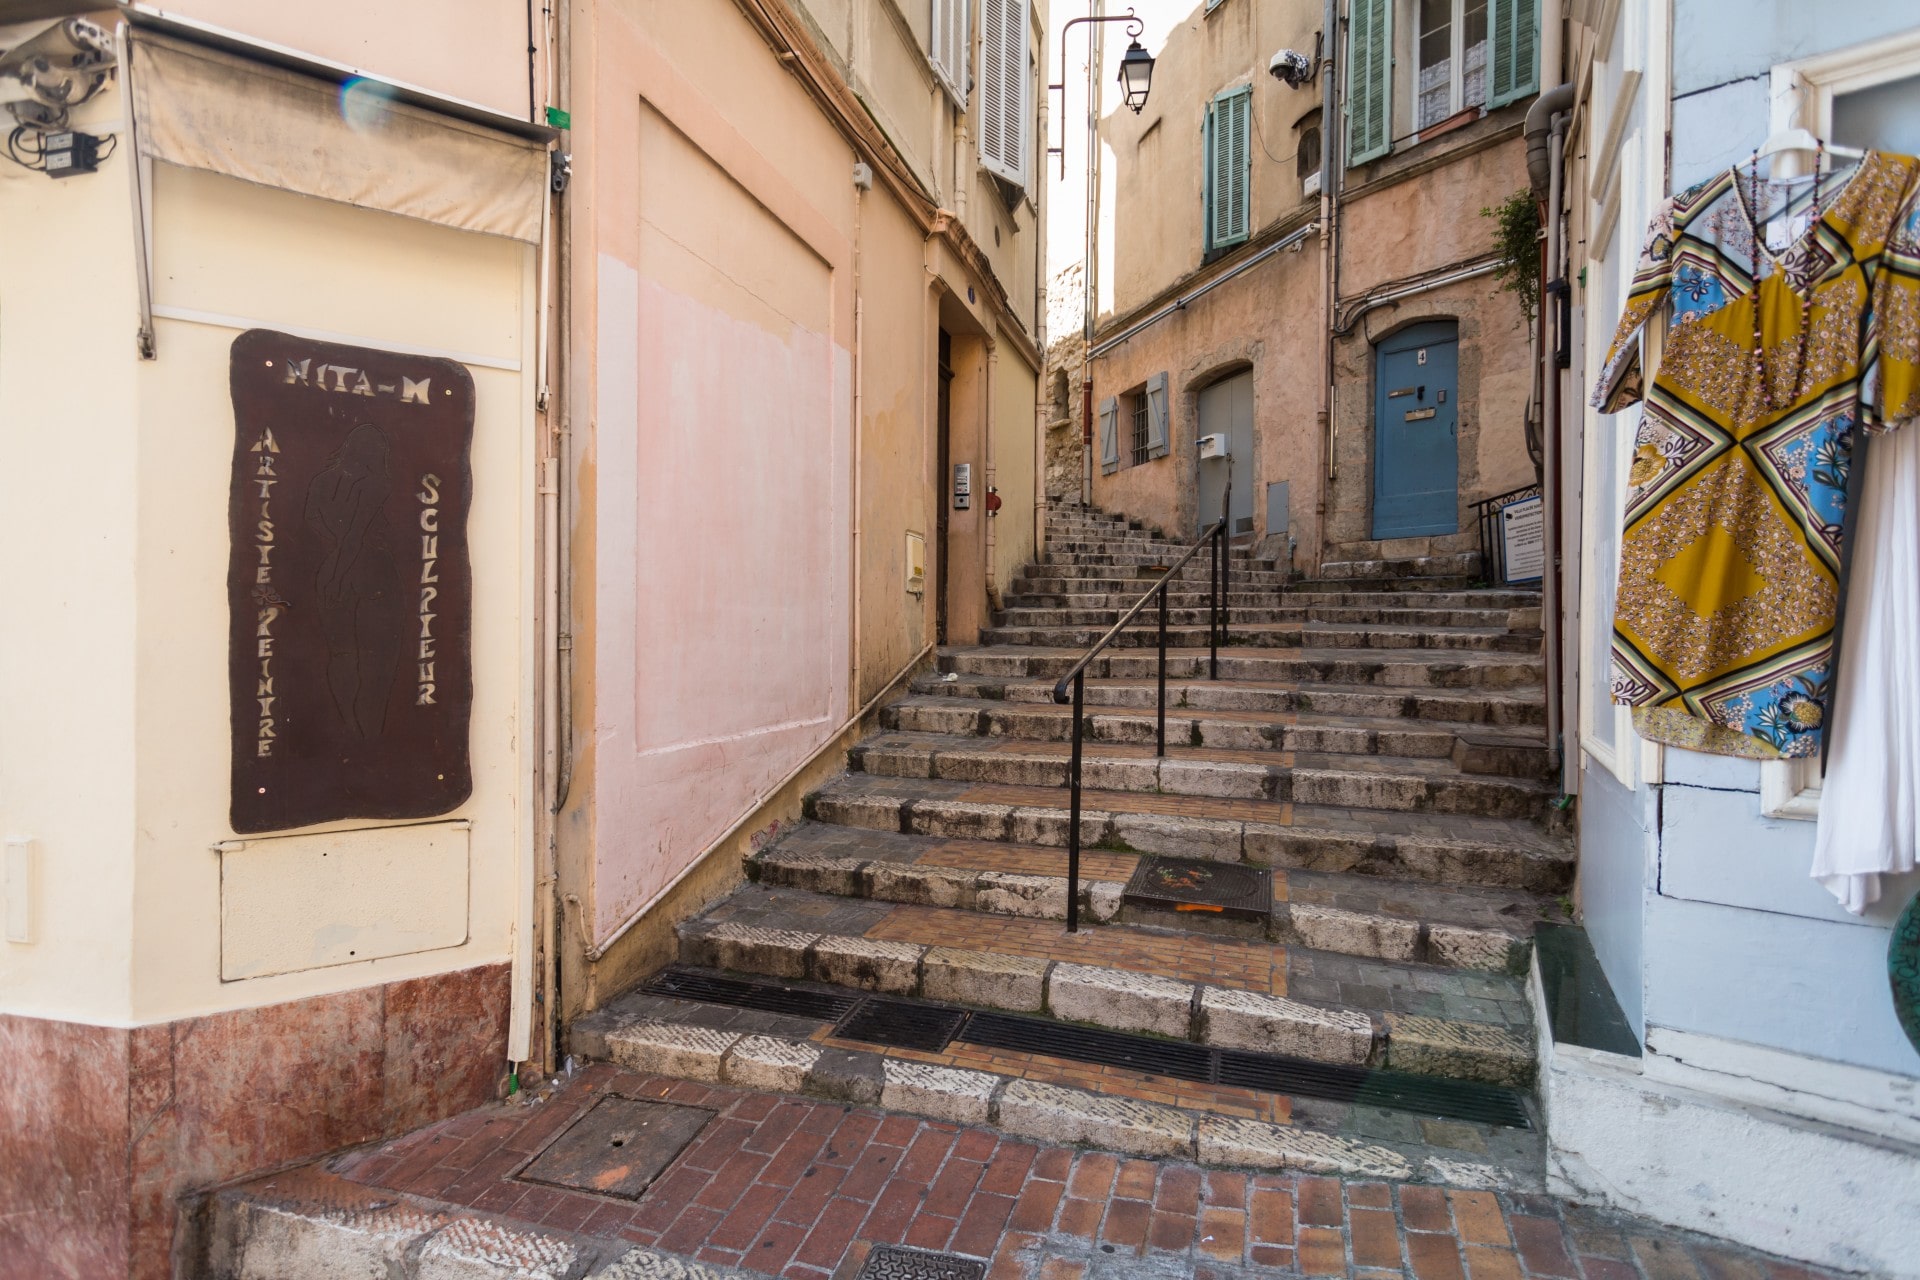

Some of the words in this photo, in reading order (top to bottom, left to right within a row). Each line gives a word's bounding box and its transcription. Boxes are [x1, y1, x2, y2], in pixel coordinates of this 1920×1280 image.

[1419, 352, 1425, 361] 4
[250, 426, 281, 584] ARTISTE
[415, 473, 442, 705] SCULPTEUR
[256, 606, 279, 757] PEINTRE
